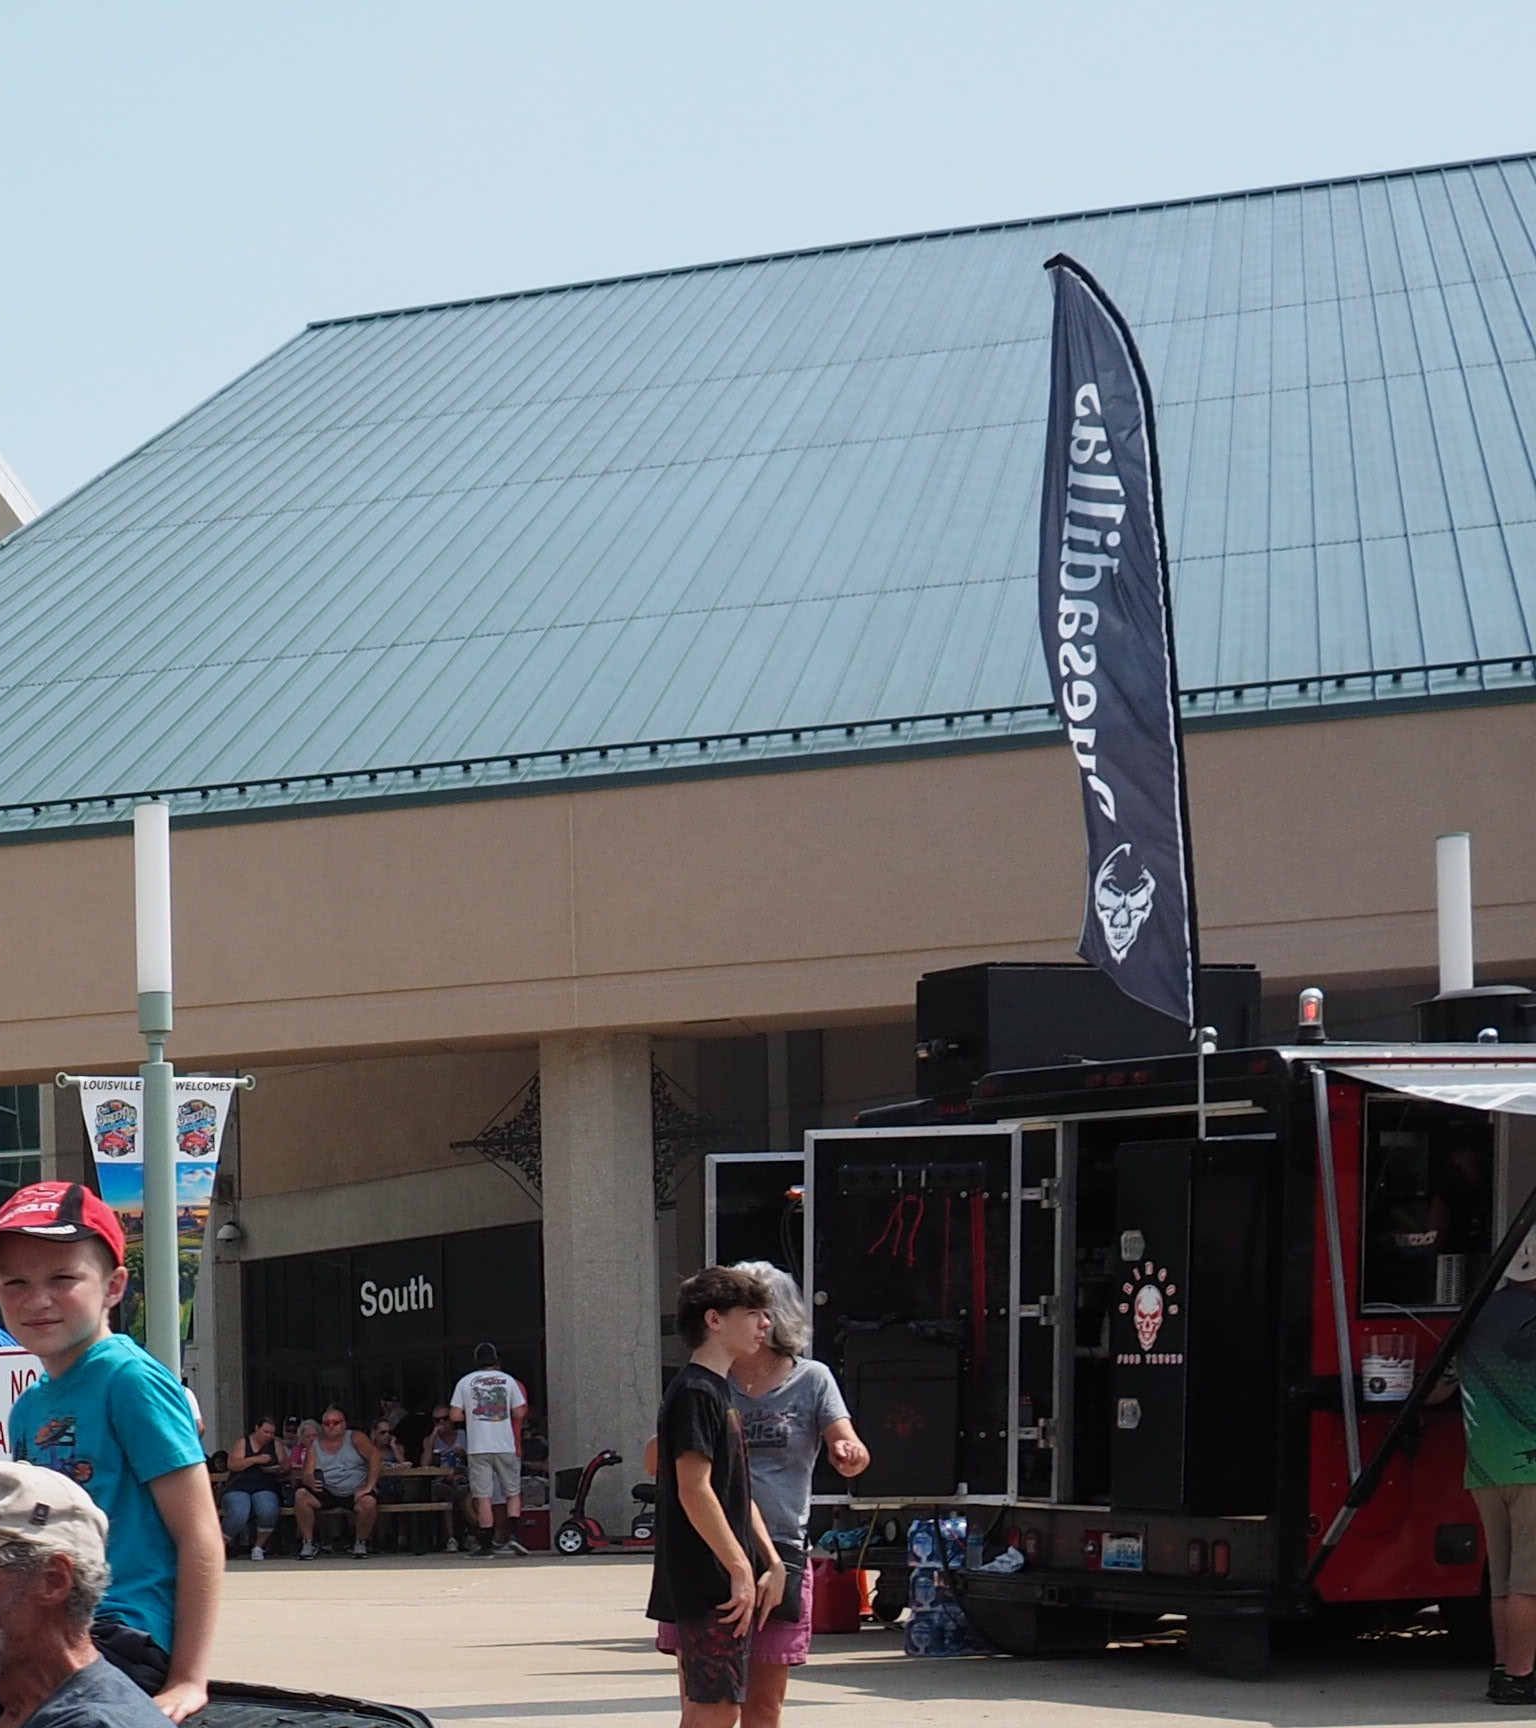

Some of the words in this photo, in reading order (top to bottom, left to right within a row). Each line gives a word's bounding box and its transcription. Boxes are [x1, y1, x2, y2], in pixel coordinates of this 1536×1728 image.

[83, 1080, 142, 1091] LOUISVILLE
[176, 1081, 232, 1092] WELCOMES
[360, 1275, 433, 1318] South
